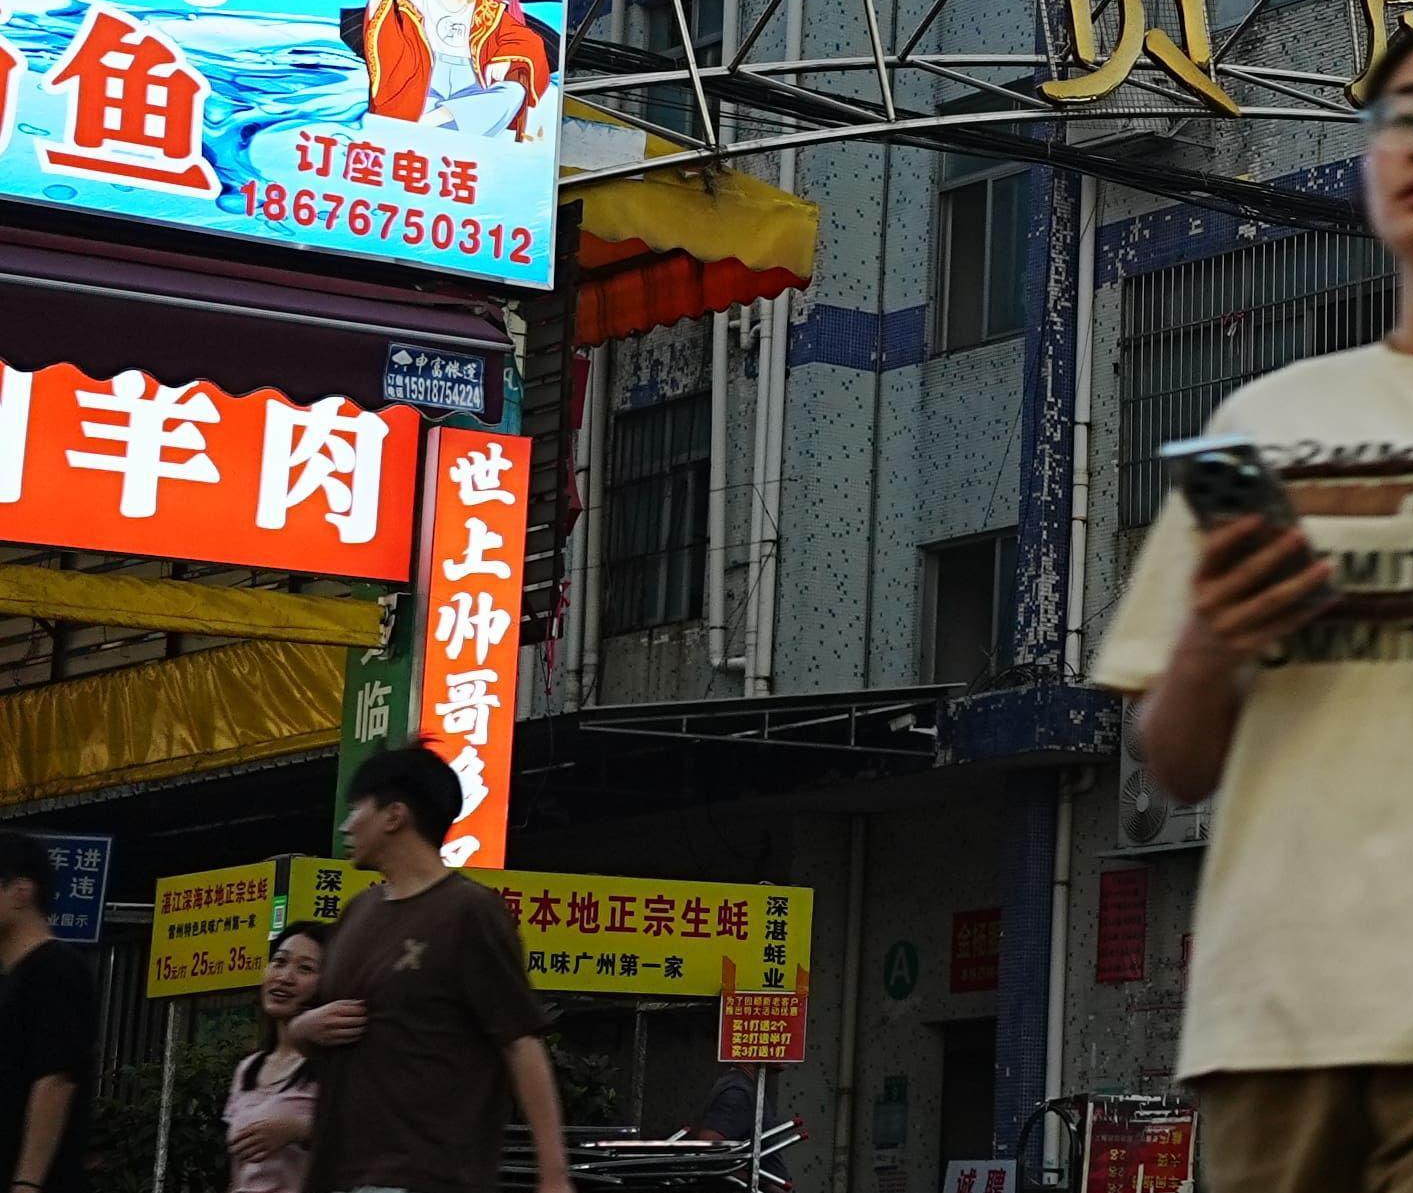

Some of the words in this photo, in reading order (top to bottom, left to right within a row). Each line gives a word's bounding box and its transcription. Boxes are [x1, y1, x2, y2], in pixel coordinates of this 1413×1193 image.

[0, 14, 212, 192] 鱼
[296, 130, 480, 205] 订座电话
[240, 181, 534, 264] 18676750312
[404, 376, 482, 408] 15918754224
[313, 870, 342, 919] 深湛
[527, 951, 684, 980] 风味广州第一家
[762, 896, 790, 989] 深湛蚝业
